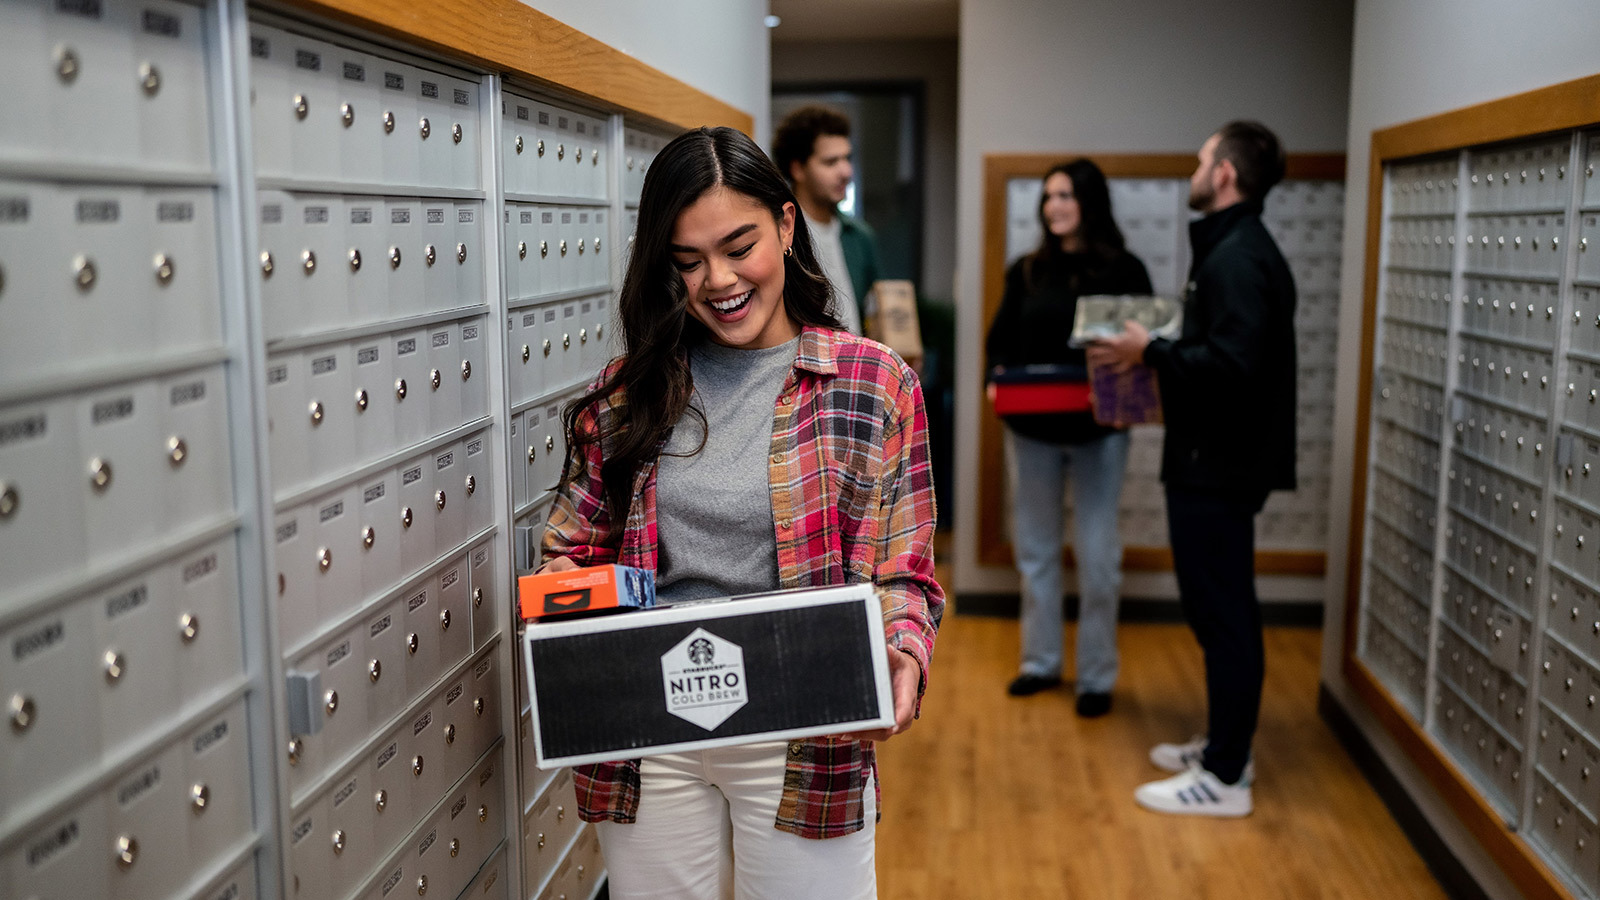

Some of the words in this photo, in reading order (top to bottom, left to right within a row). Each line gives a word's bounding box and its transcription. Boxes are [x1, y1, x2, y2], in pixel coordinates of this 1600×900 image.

[670, 672, 739, 694] NITRO
[672, 693, 704, 705] COLD
[708, 689, 740, 701] BREW
